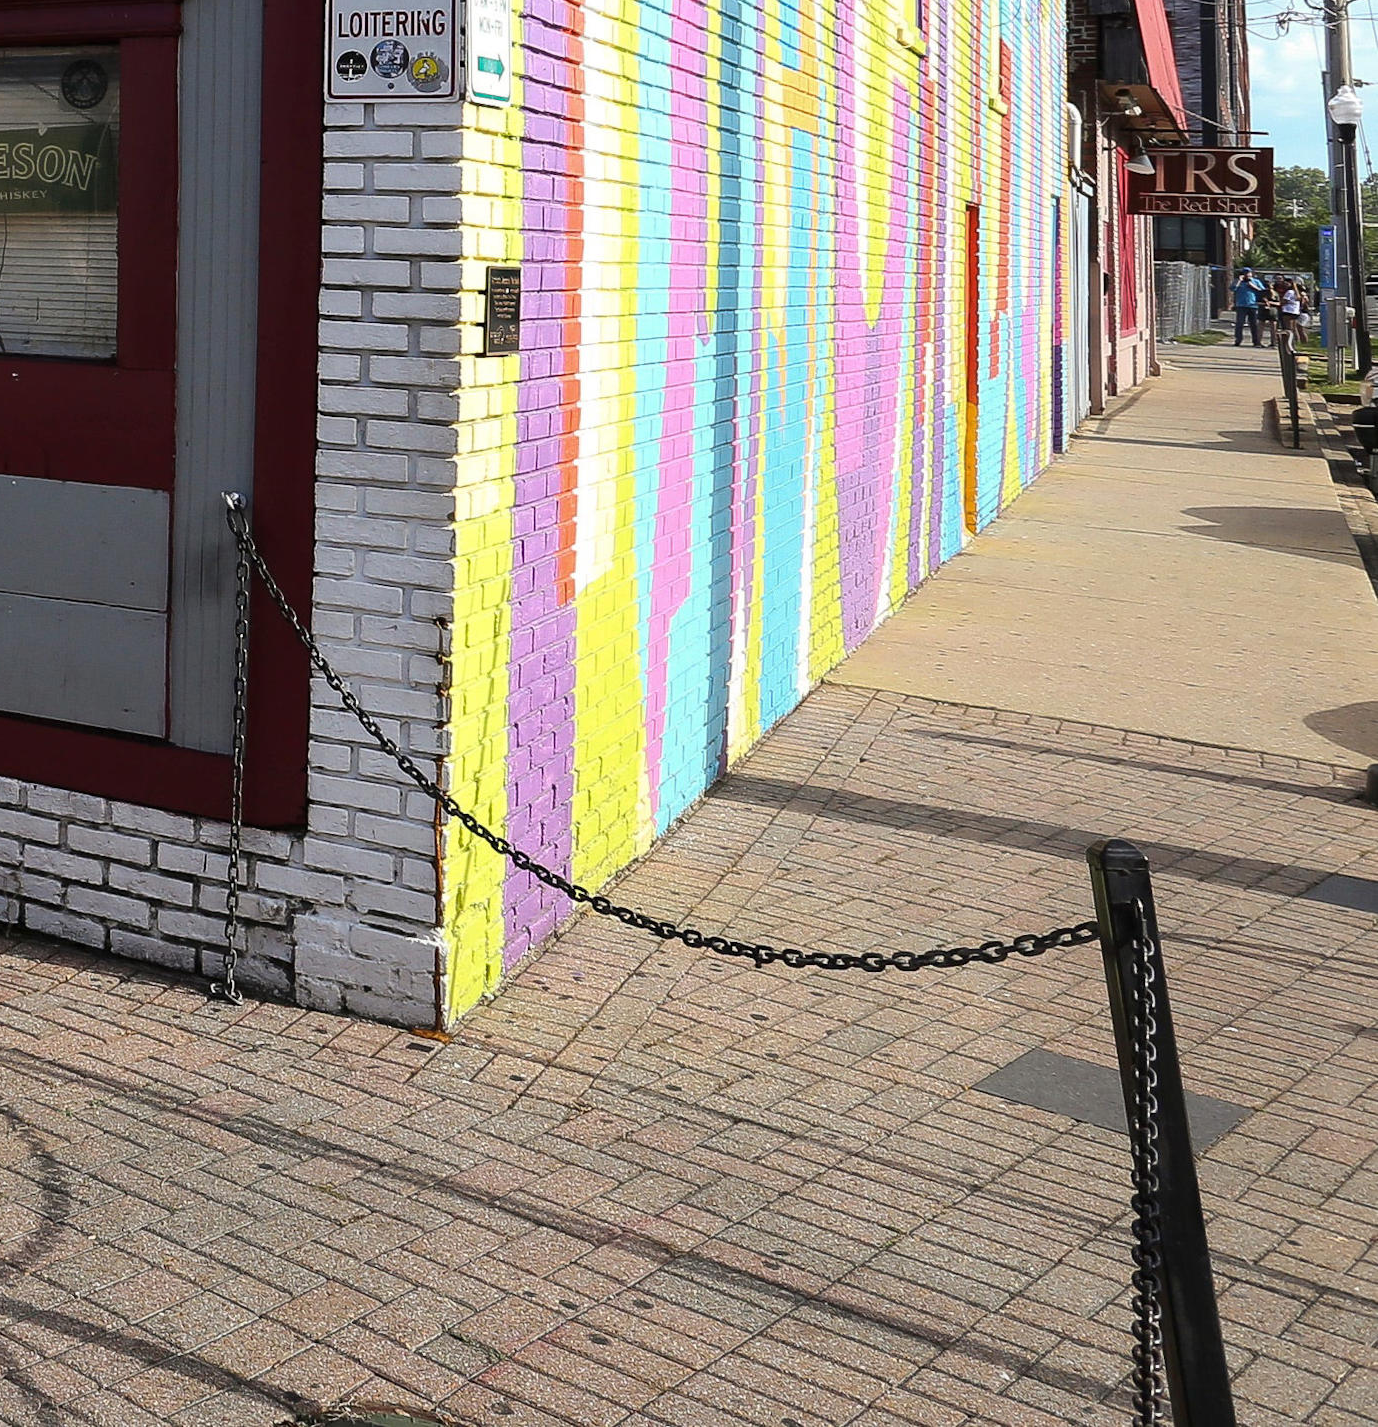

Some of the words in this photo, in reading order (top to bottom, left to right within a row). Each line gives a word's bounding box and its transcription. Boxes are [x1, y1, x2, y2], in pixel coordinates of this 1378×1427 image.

[338, 10, 446, 37] LOITERING
[1147, 152, 1259, 196] TRS
[1144, 197, 1171, 211] The
[1179, 197, 1211, 212] Red
[1217, 197, 1259, 214] Shed
